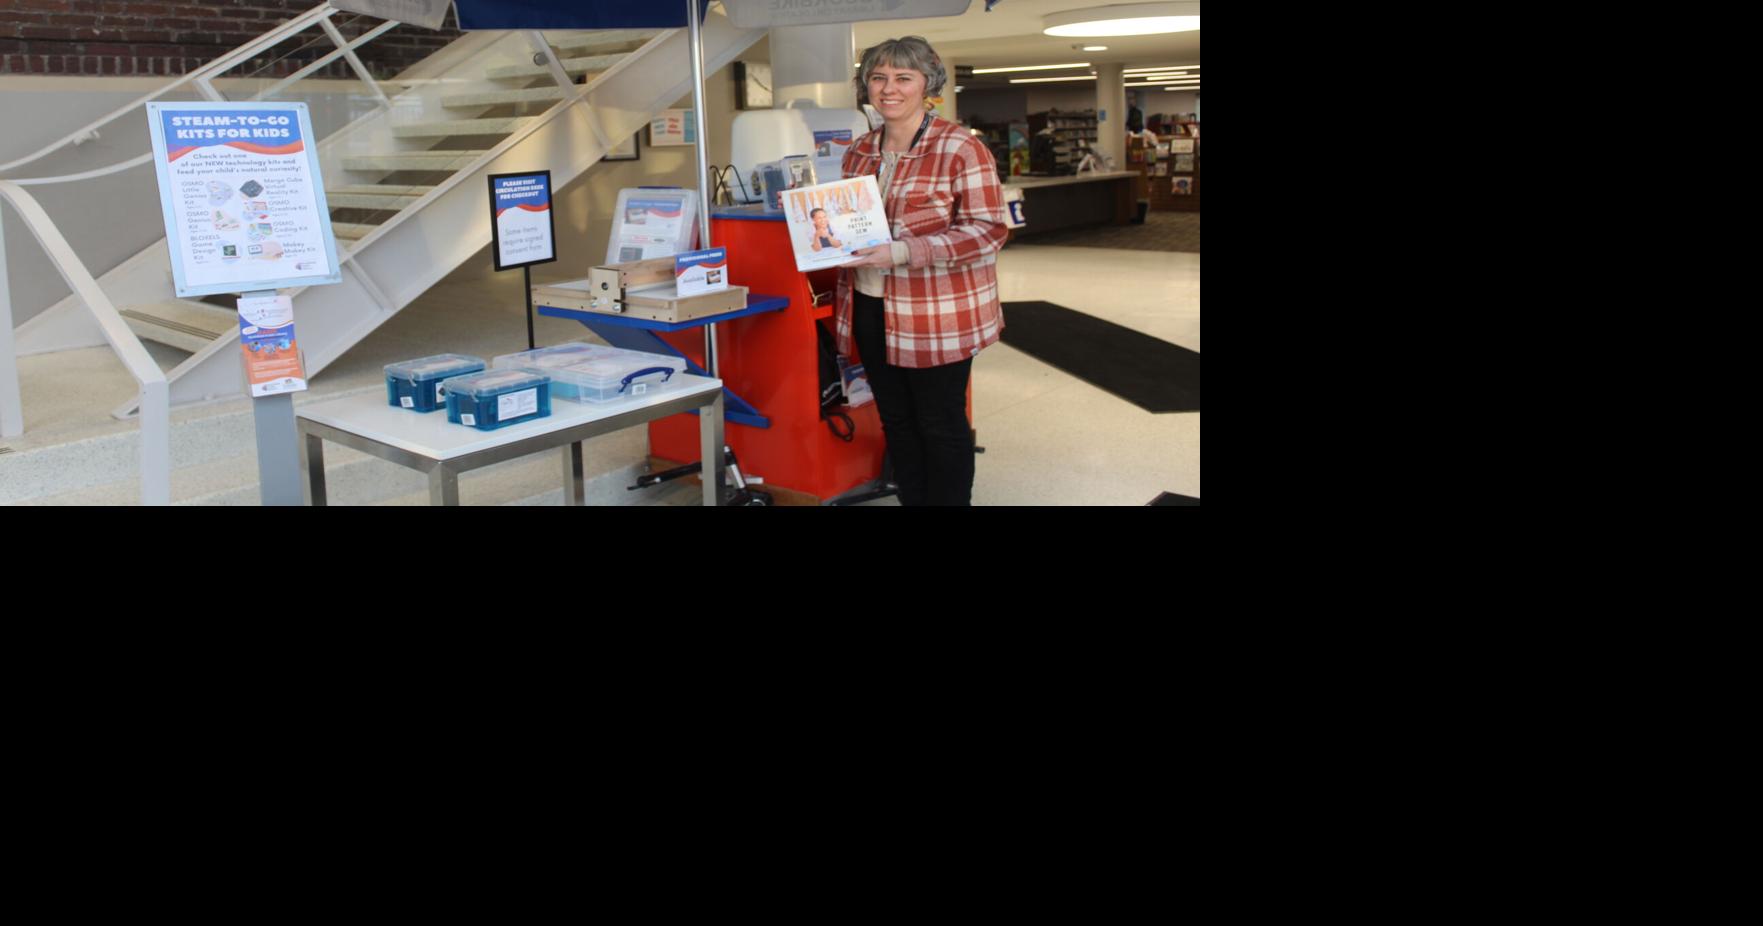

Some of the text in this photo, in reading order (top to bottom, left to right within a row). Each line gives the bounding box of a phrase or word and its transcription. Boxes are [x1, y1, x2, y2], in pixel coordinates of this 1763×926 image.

[172, 116, 290, 126] STEAM-TO-GO
[177, 128, 290, 139] KITS FOR KIDS
[225, 160, 267, 168] technology
[511, 191, 539, 199] CHECKOUT
